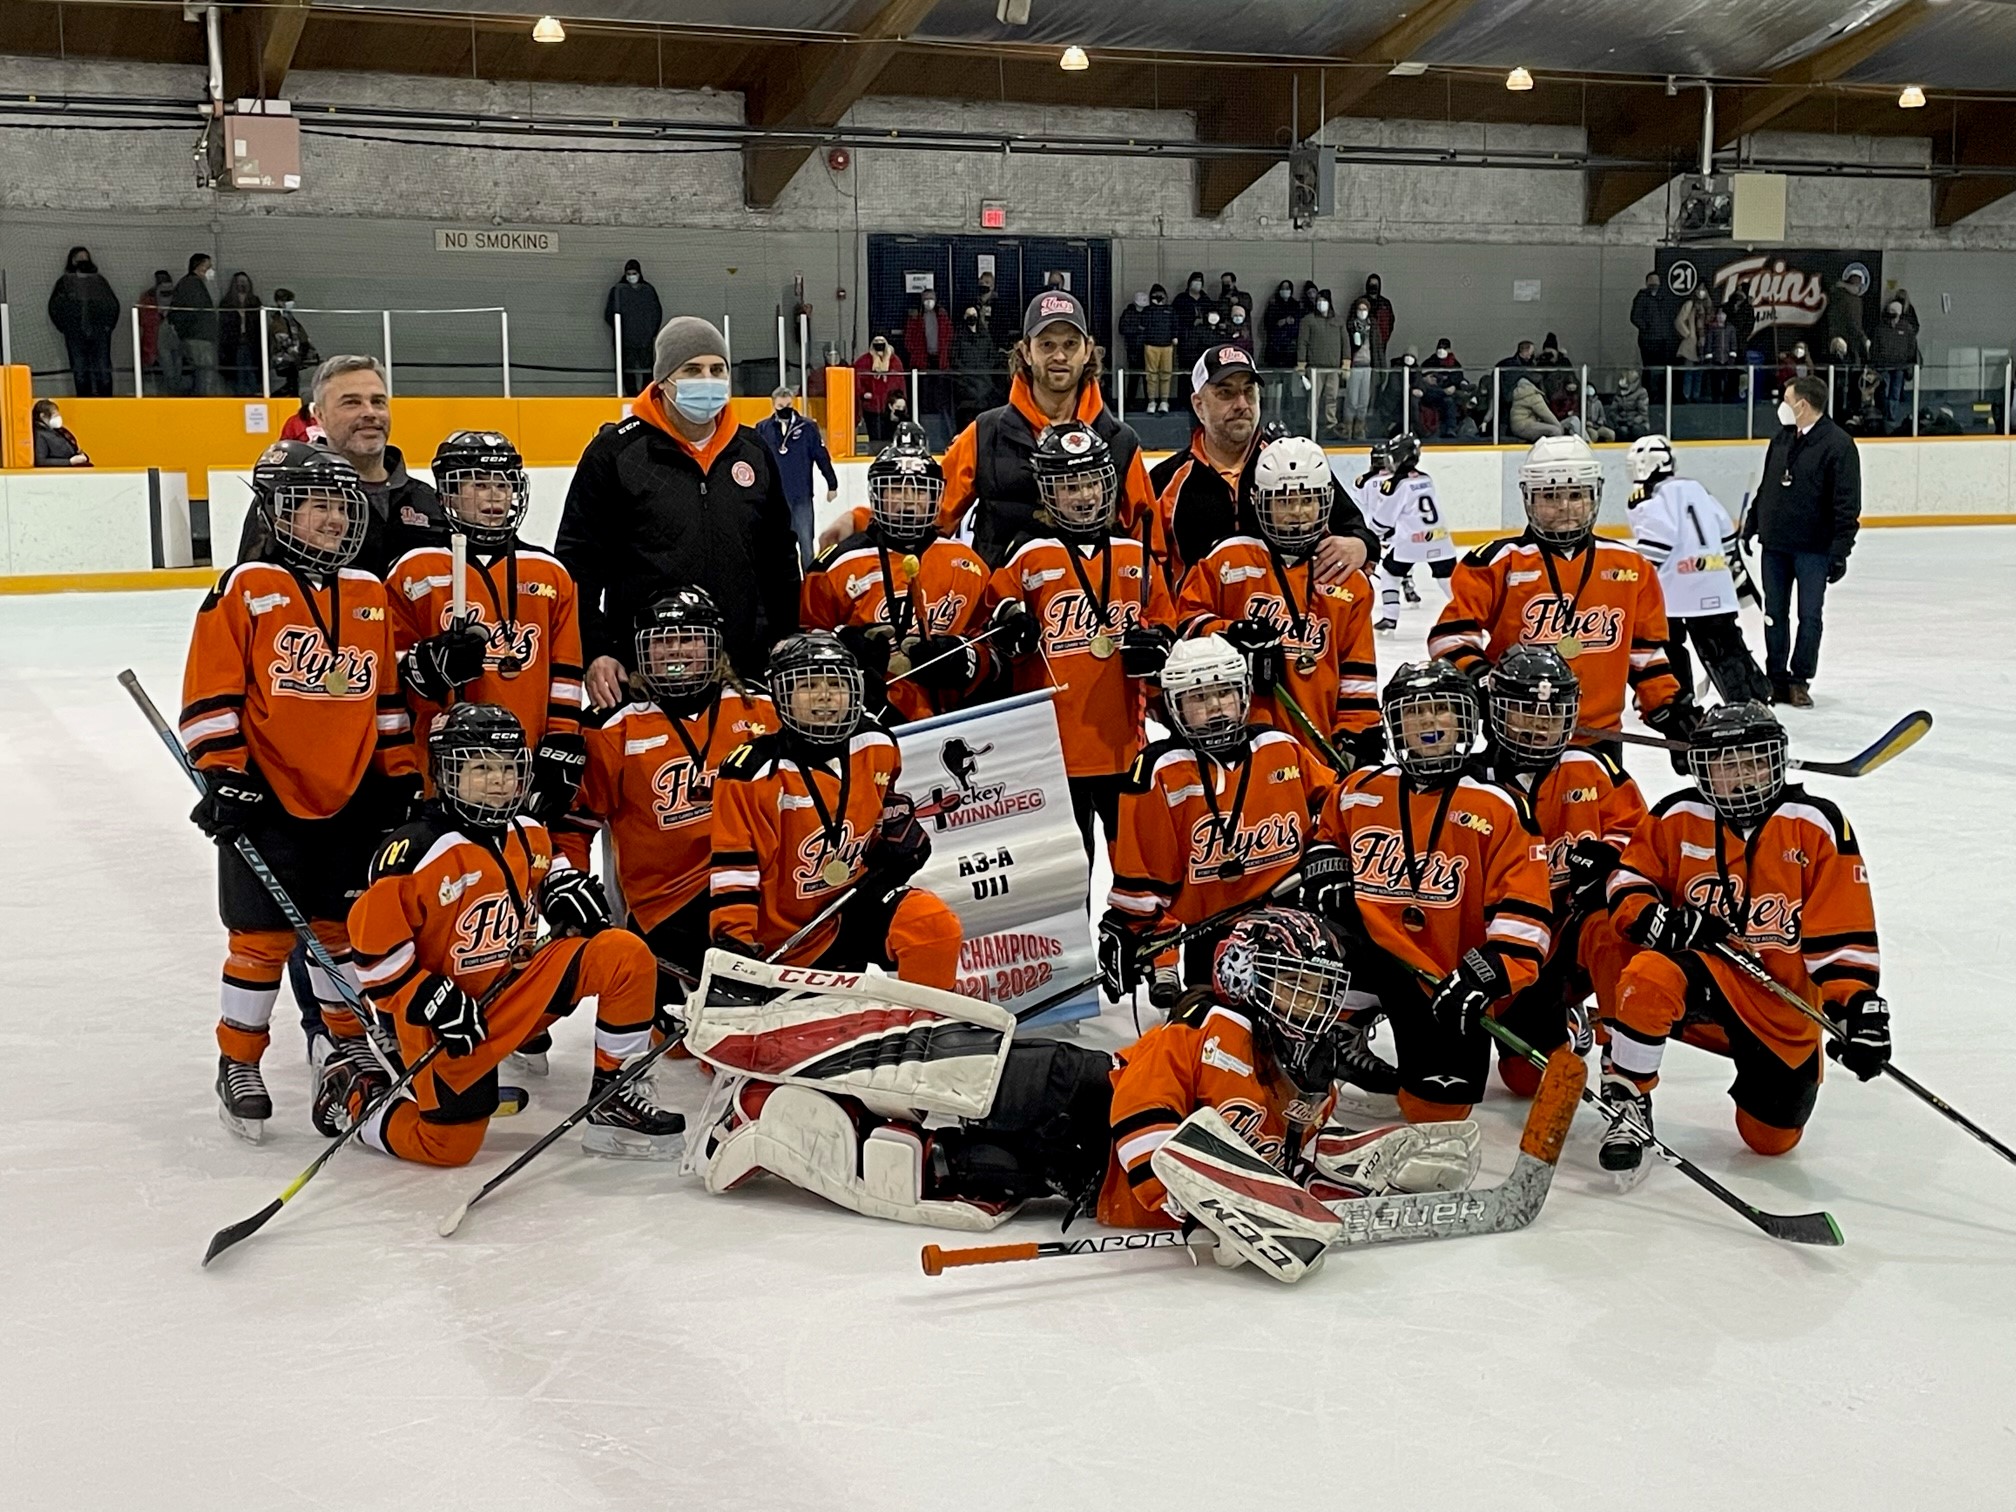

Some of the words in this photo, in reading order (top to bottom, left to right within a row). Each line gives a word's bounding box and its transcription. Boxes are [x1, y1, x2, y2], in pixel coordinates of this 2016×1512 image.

[445, 232, 468, 248] NO
[475, 232, 549, 250] SMOKING
[1672, 268, 1693, 289] 21
[1419, 496, 1438, 524] 9
[1686, 505, 1706, 546] 1
[540, 747, 586, 765] BAUE
[948, 792, 1042, 827] WINNIPEG
[1192, 815, 1299, 863] Fyers
[958, 846, 1015, 878] A3-A
[971, 875, 1009, 900] U11
[1643, 903, 1669, 949] UER
[959, 934, 1063, 973] CHAMPIONS
[778, 968, 860, 988] CCM
[954, 962, 1053, 1002] 21-2022
[424, 976, 453, 1021] BAU
[1345, 1200, 1486, 1234] BAUER
[1062, 1231, 1180, 1254] VAPOR
[1199, 1199, 1293, 1271] CCM
